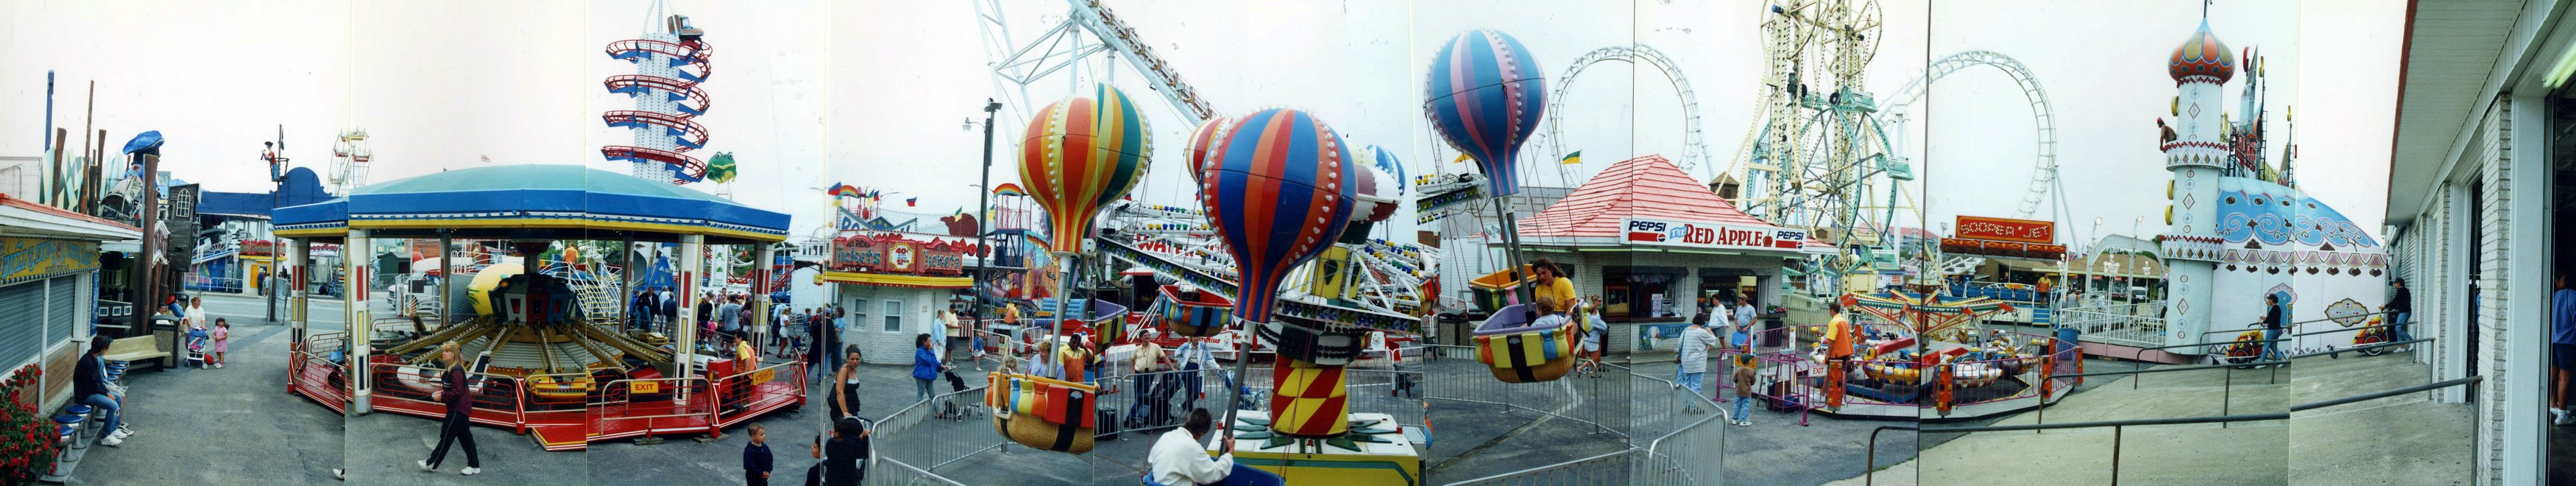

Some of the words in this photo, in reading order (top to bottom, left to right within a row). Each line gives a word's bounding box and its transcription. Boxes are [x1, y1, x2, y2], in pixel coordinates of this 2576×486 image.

[1629, 221, 1666, 232] PEPSI
[1961, 222, 2014, 236] SOOPER
[2023, 225, 2048, 238] JET
[1683, 224, 1714, 244] RED
[1717, 227, 1762, 247] APPLE
[1777, 230, 1803, 241] PEPSI
